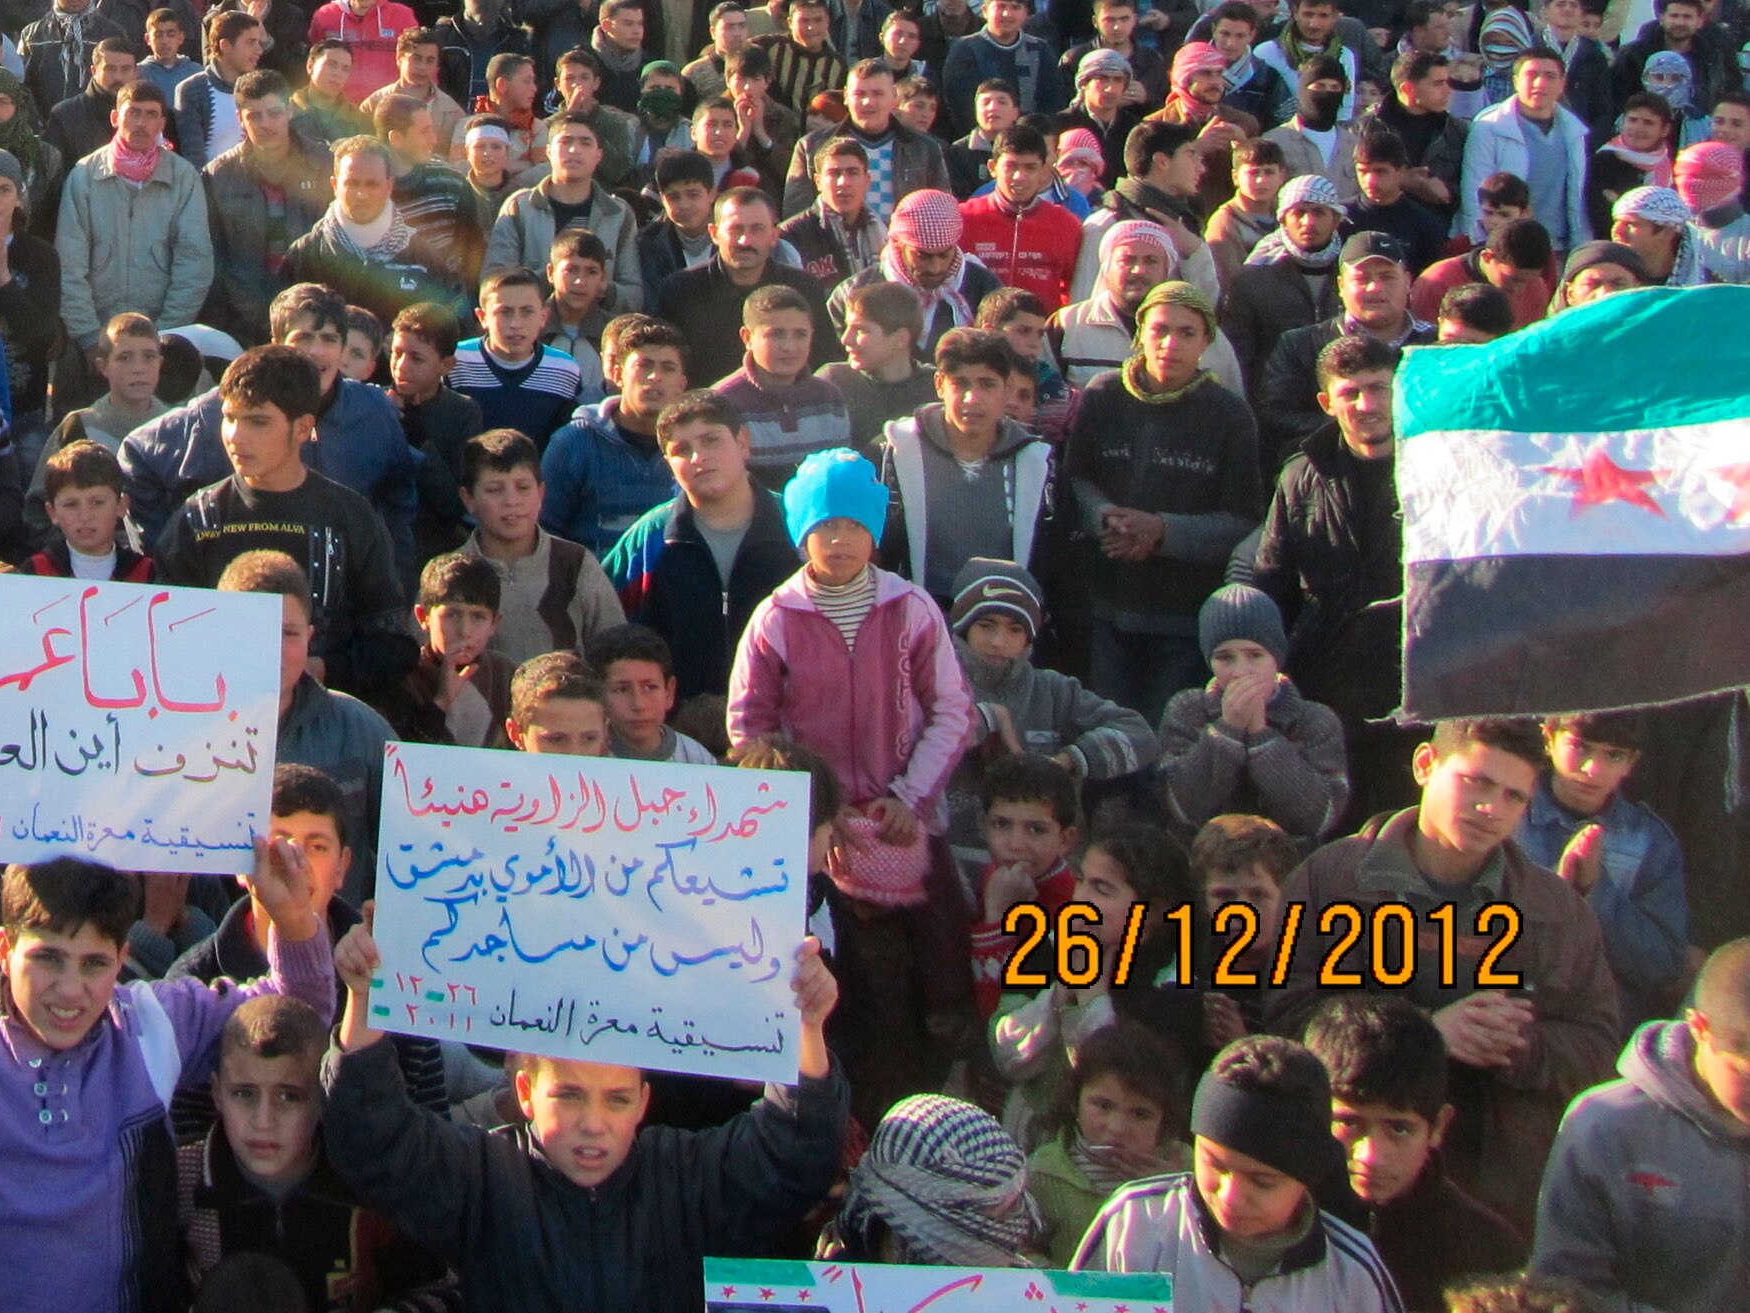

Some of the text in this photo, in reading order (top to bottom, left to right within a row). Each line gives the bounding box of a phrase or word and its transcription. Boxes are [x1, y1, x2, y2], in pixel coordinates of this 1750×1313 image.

[53, 712, 123, 777] أين
[133, 726, 260, 783] تنزف
[11, 802, 86, 845] النعمان
[490, 771, 608, 833] الزاوية
[612, 774, 688, 832] جبل
[687, 782, 790, 843] شهداء
[85, 819, 137, 852] معرة
[140, 812, 258, 858] تنسيقية
[385, 841, 488, 898] بدمشق
[490, 835, 597, 904] الأموي
[604, 853, 644, 896] من
[421, 895, 783, 984] وليس من مساجدكم
[489, 988, 576, 1039] النعمان
[579, 1001, 639, 1046] معرة
[646, 1006, 786, 1057] تنسيقية
